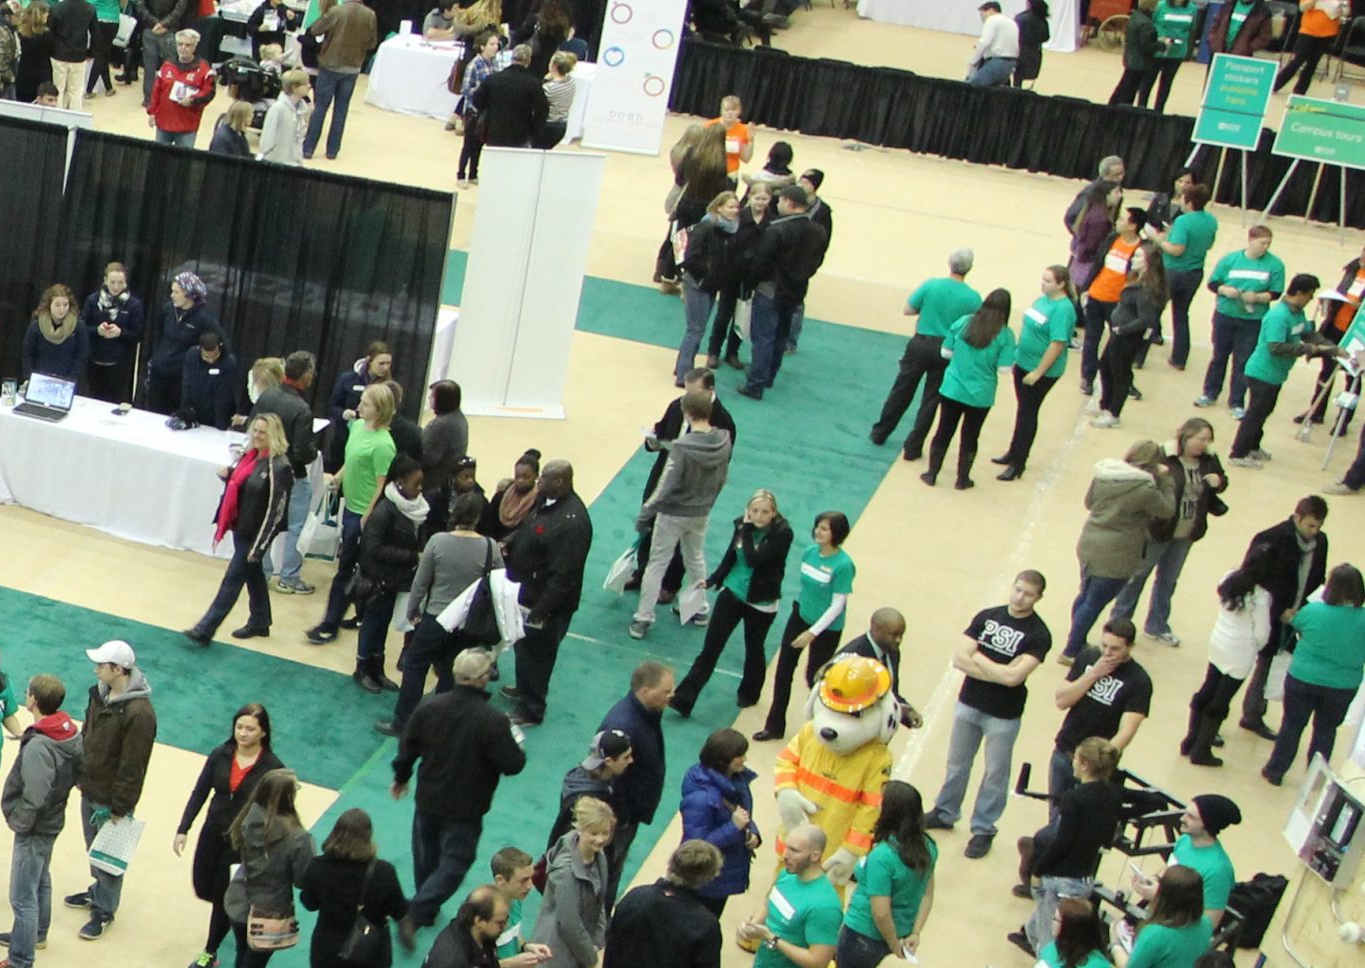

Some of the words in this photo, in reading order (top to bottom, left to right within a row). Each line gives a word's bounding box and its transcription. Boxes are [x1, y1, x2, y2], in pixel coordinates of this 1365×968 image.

[1225, 61, 1265, 75] Passport
[1291, 122, 1333, 139] Campus
[1335, 128, 1363, 143] tours
[977, 619, 1025, 654] PSI
